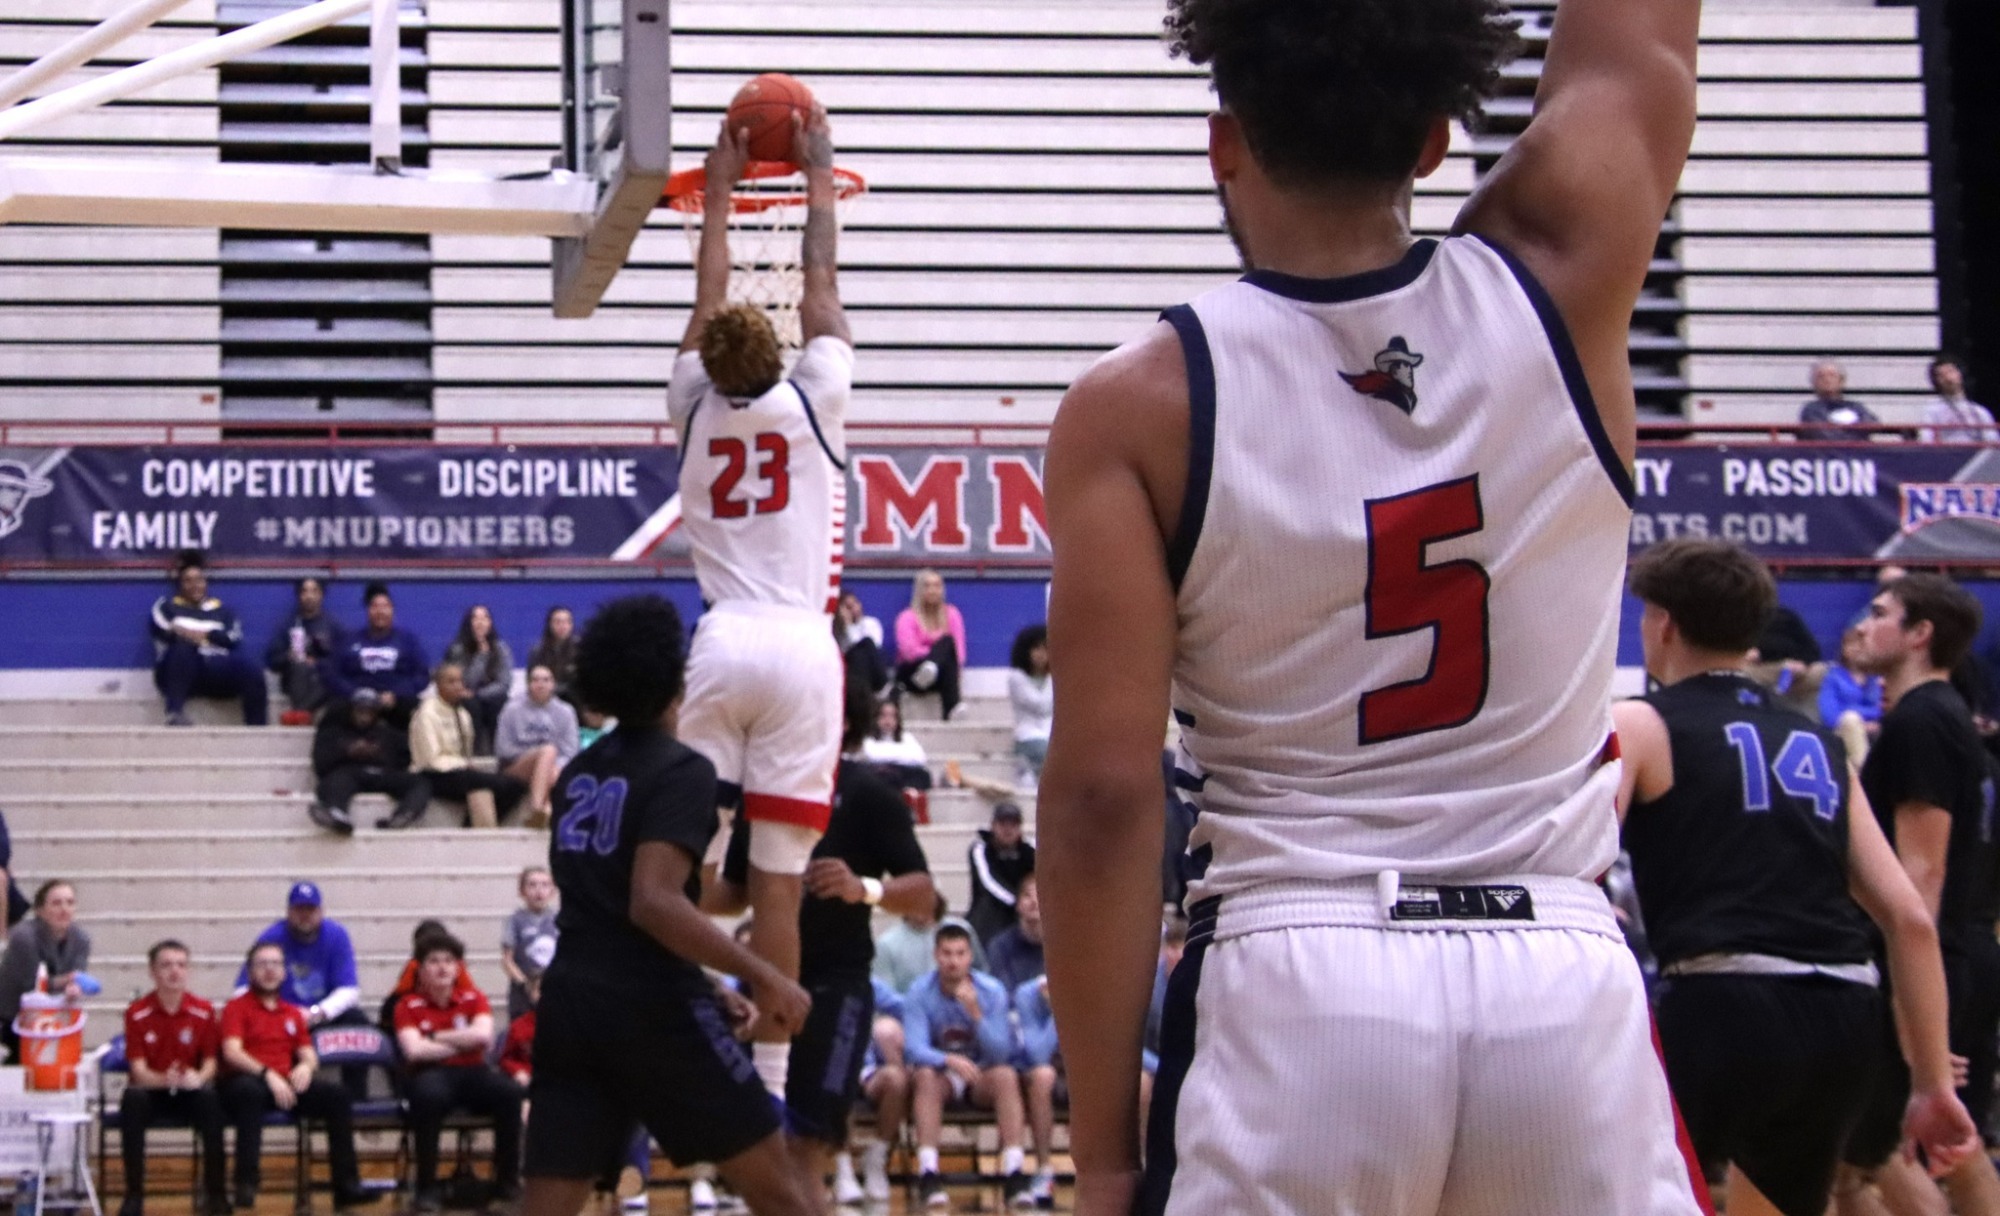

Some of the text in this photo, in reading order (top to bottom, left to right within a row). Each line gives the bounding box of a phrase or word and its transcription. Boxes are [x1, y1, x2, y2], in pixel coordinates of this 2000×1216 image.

[142, 459, 638, 498] COMPETITIVE DISCIPLINE
[708, 432, 789, 518] 23
[852, 455, 1052, 552] MN
[1633, 459, 1878, 497] TY PASSION
[92, 511, 576, 549] FAMILY #MNUPIONEERS
[1631, 512, 1808, 545] RTS.COM
[1358, 472, 1491, 746] 5
[1723, 721, 1839, 820] 14
[557, 772, 628, 855] 20
